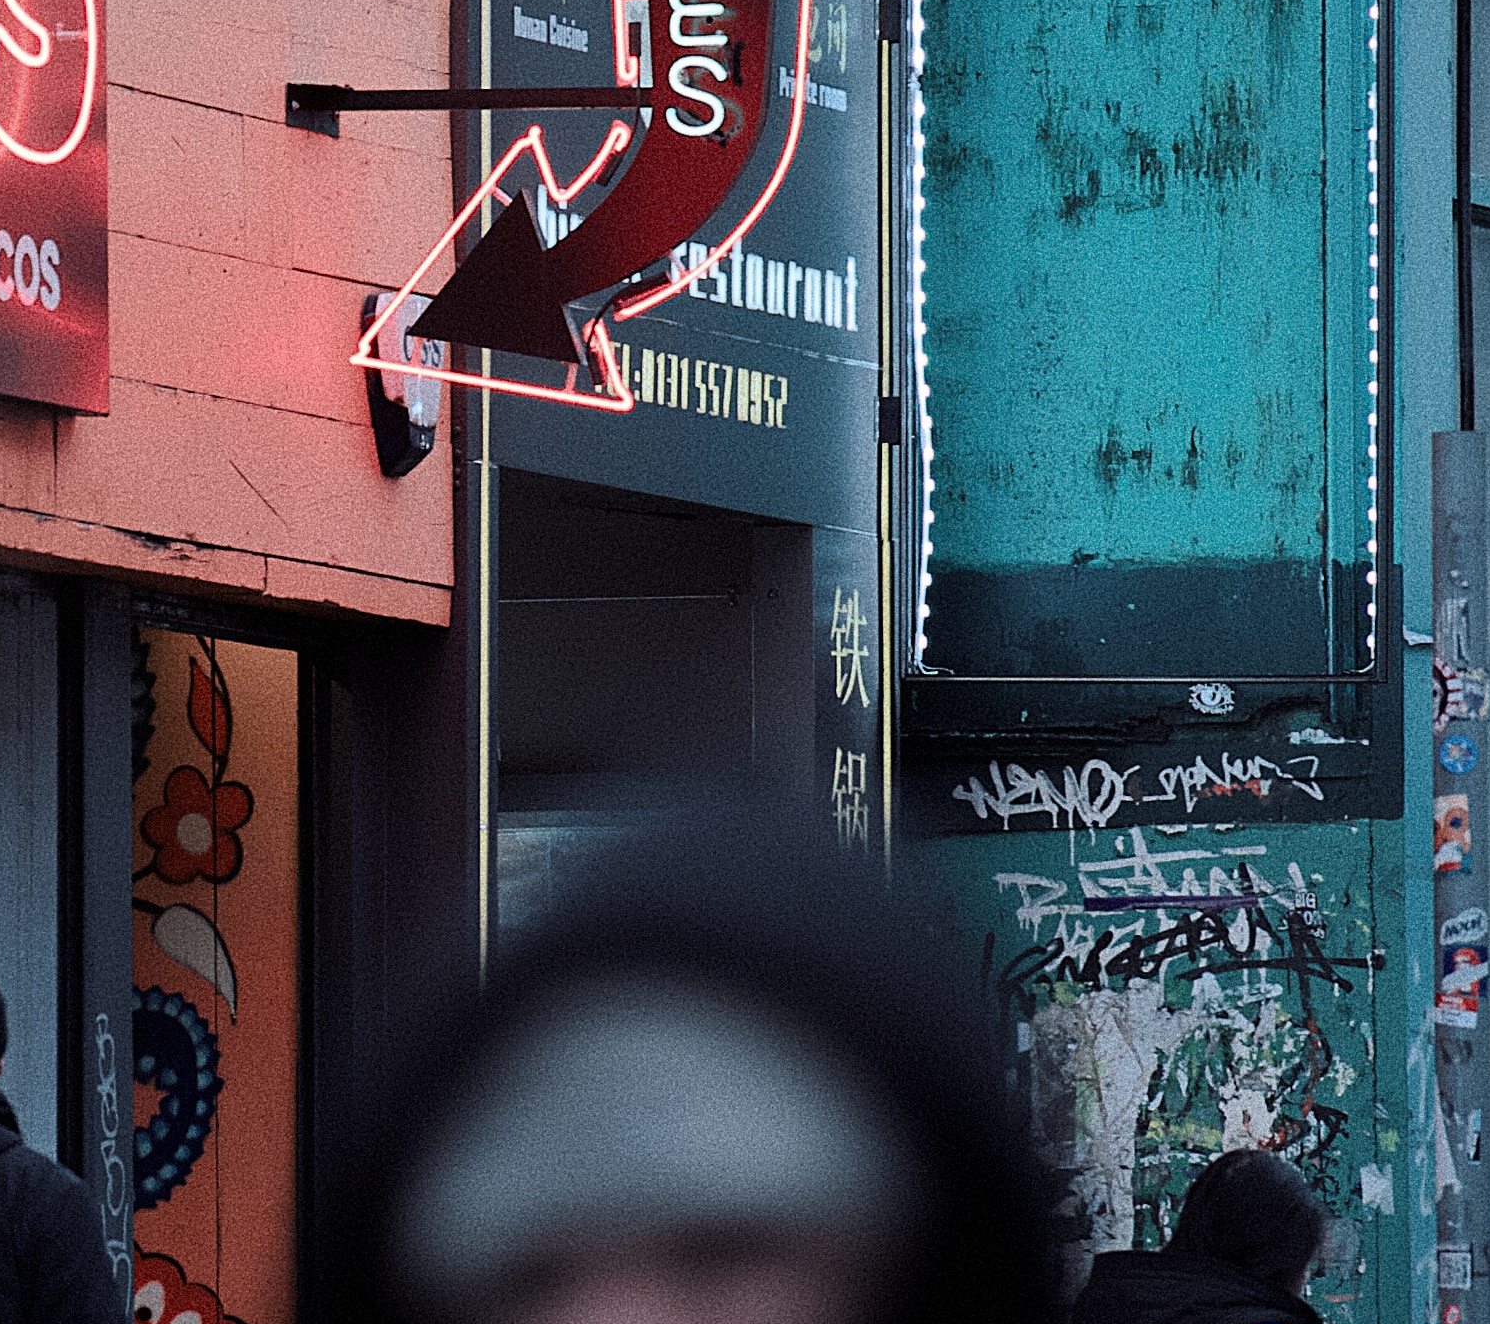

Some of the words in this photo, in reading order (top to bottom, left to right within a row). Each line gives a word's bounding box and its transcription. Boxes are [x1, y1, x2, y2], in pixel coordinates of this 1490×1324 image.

[513, 5, 548, 43] Hunan
[549, 15, 589, 53] Cuisine
[694, 358, 734, 418] 557
[736, 366, 789, 429] 0952
